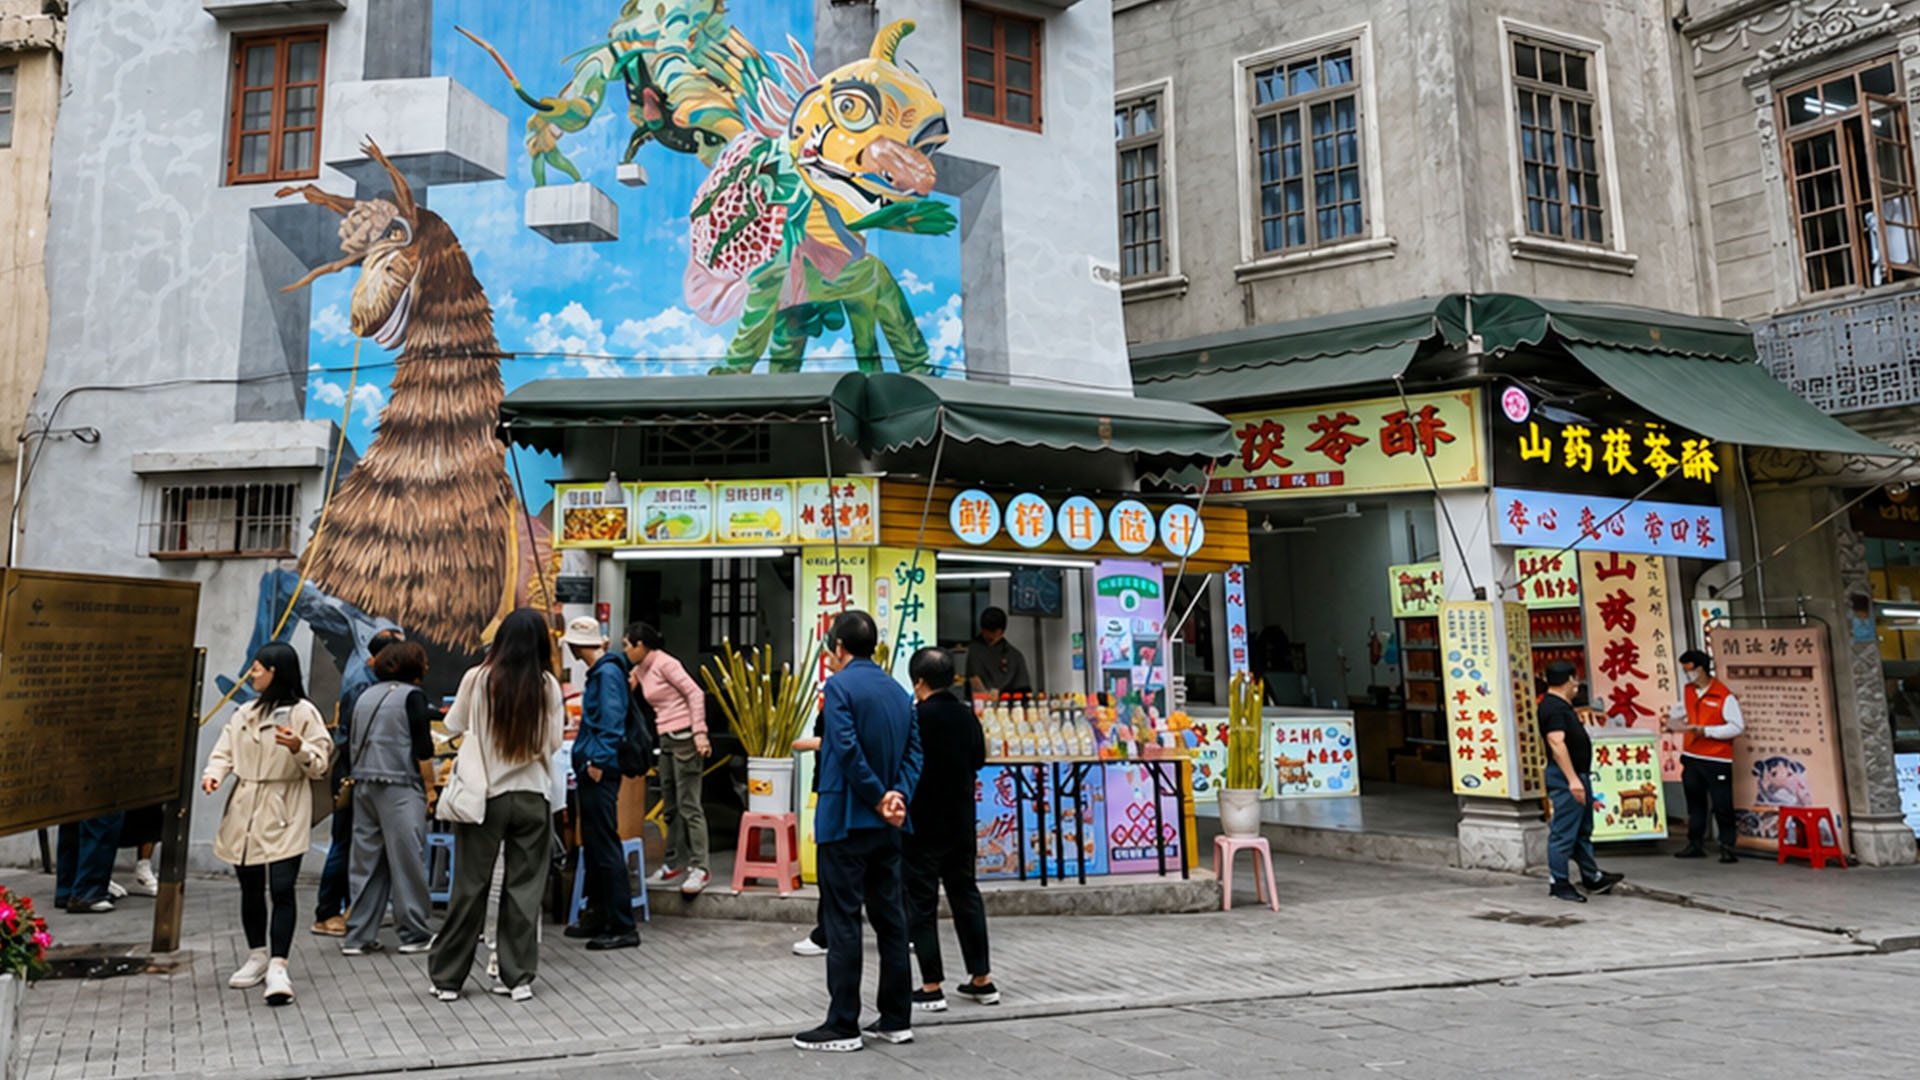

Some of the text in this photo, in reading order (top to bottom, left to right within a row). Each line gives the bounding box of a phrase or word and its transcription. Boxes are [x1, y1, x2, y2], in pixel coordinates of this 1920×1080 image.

[1236, 404, 1456, 473] 茯苓酥
[1518, 422, 1720, 484] 山药茯苓酥
